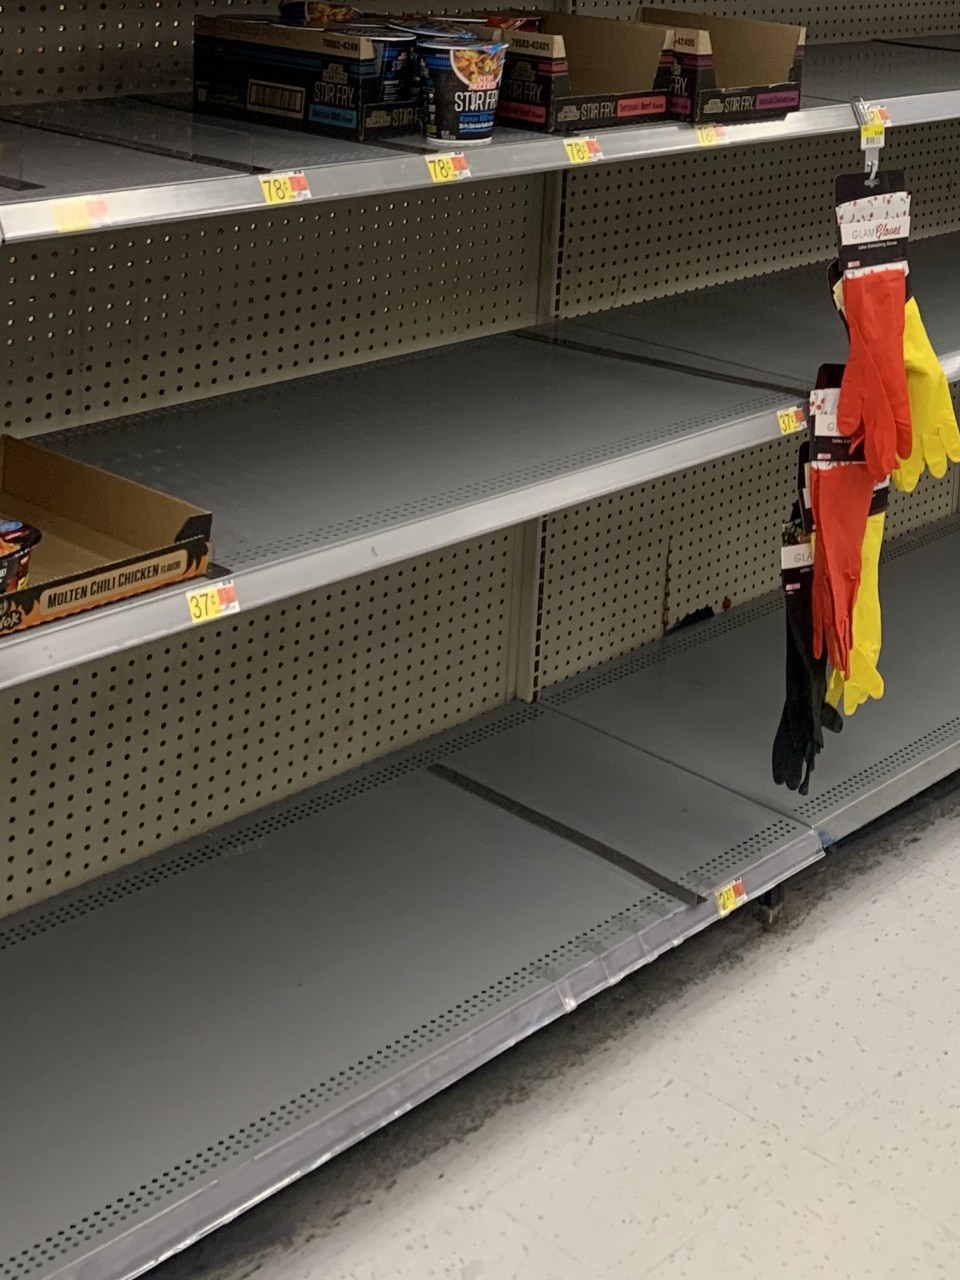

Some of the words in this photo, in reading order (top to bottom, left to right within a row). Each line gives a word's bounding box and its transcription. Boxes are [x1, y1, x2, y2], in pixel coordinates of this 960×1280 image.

[314, 81, 334, 103] STIR
[335, 84, 356, 108] FRY
[454, 90, 485, 112] STIR
[485, 90, 499, 111] FR
[524, 82, 543, 103] FRY
[581, 102, 598, 121] STIR
[599, 101, 617, 119] FRY
[724, 97, 740, 113] STIR
[741, 95, 756, 110] FRY
[263, 180, 289, 202] 78¢
[851, 227, 875, 240] GLAM
[875, 223, 902, 240] Gloves
[793, 552, 815, 564] GLA
[47, 583, 88, 610] MOLTEN
[89, 574, 117, 597] CHILI
[117, 563, 160, 587] CHICKEN
[160, 559, 181, 575] FLAVOR
[189, 593, 217, 620] 37¢
